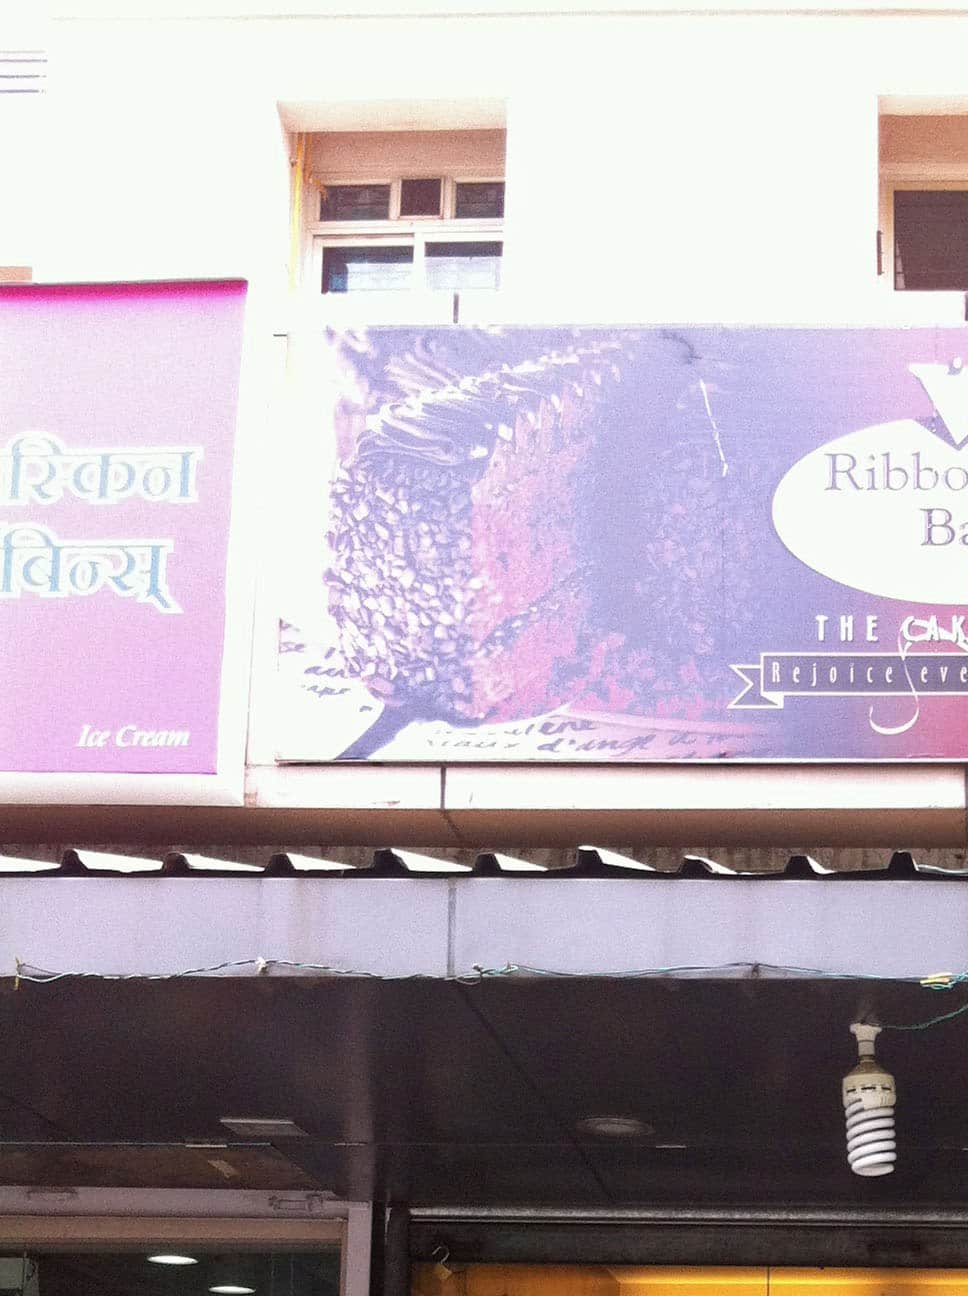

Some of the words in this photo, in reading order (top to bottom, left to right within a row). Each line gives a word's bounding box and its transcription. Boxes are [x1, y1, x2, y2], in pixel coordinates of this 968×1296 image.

[815, 615, 880, 642] THE
[771, 661, 894, 688] Rejoice
[77, 724, 109, 747] Ice
[115, 723, 191, 748] Cream
